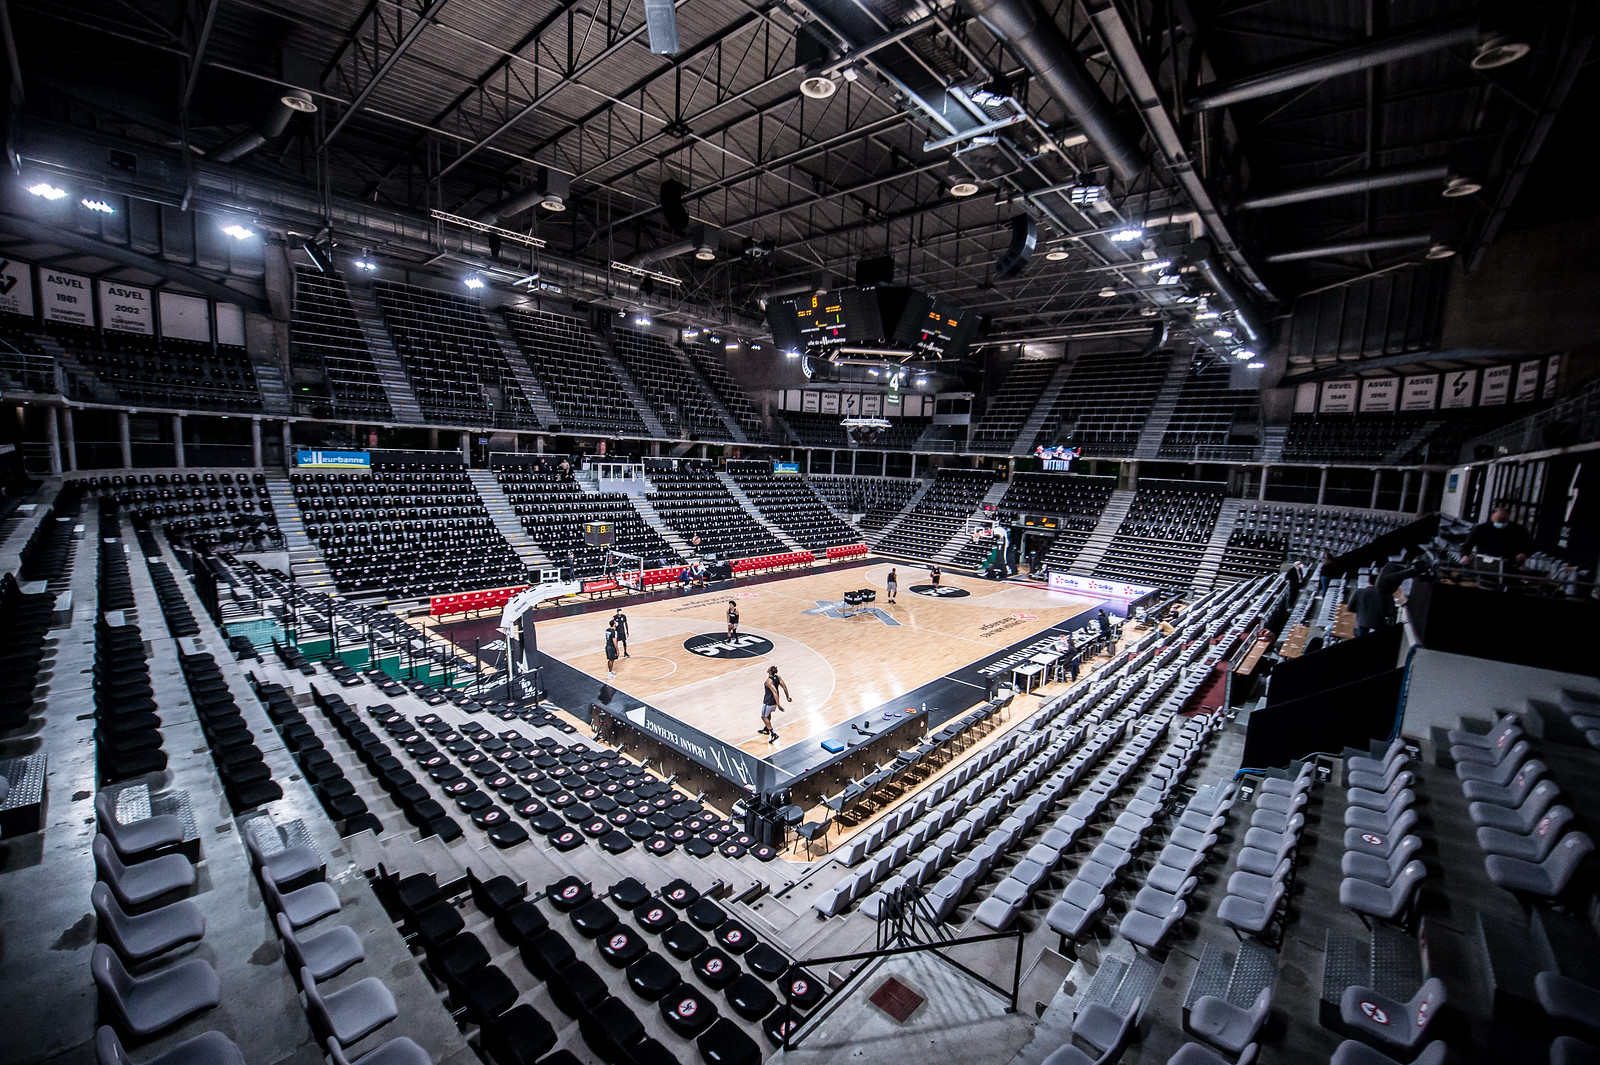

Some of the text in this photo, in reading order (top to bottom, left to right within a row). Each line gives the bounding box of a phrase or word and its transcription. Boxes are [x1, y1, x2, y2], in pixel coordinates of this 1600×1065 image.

[47, 274, 84, 290] ASVEL
[56, 293, 77, 304] 1981
[108, 287, 144, 301] ASVEL
[50, 307, 85, 318] CHAMPION
[115, 304, 139, 315] 2002
[111, 317, 145, 327] CHAMPION
[890, 373, 899, 391] 4
[303, 451, 364, 464] villeurbanne
[1043, 460, 1070, 471] WITHIN
[646, 719, 679, 744] EXCHANGE
[680, 737, 706, 760] ARMANI
